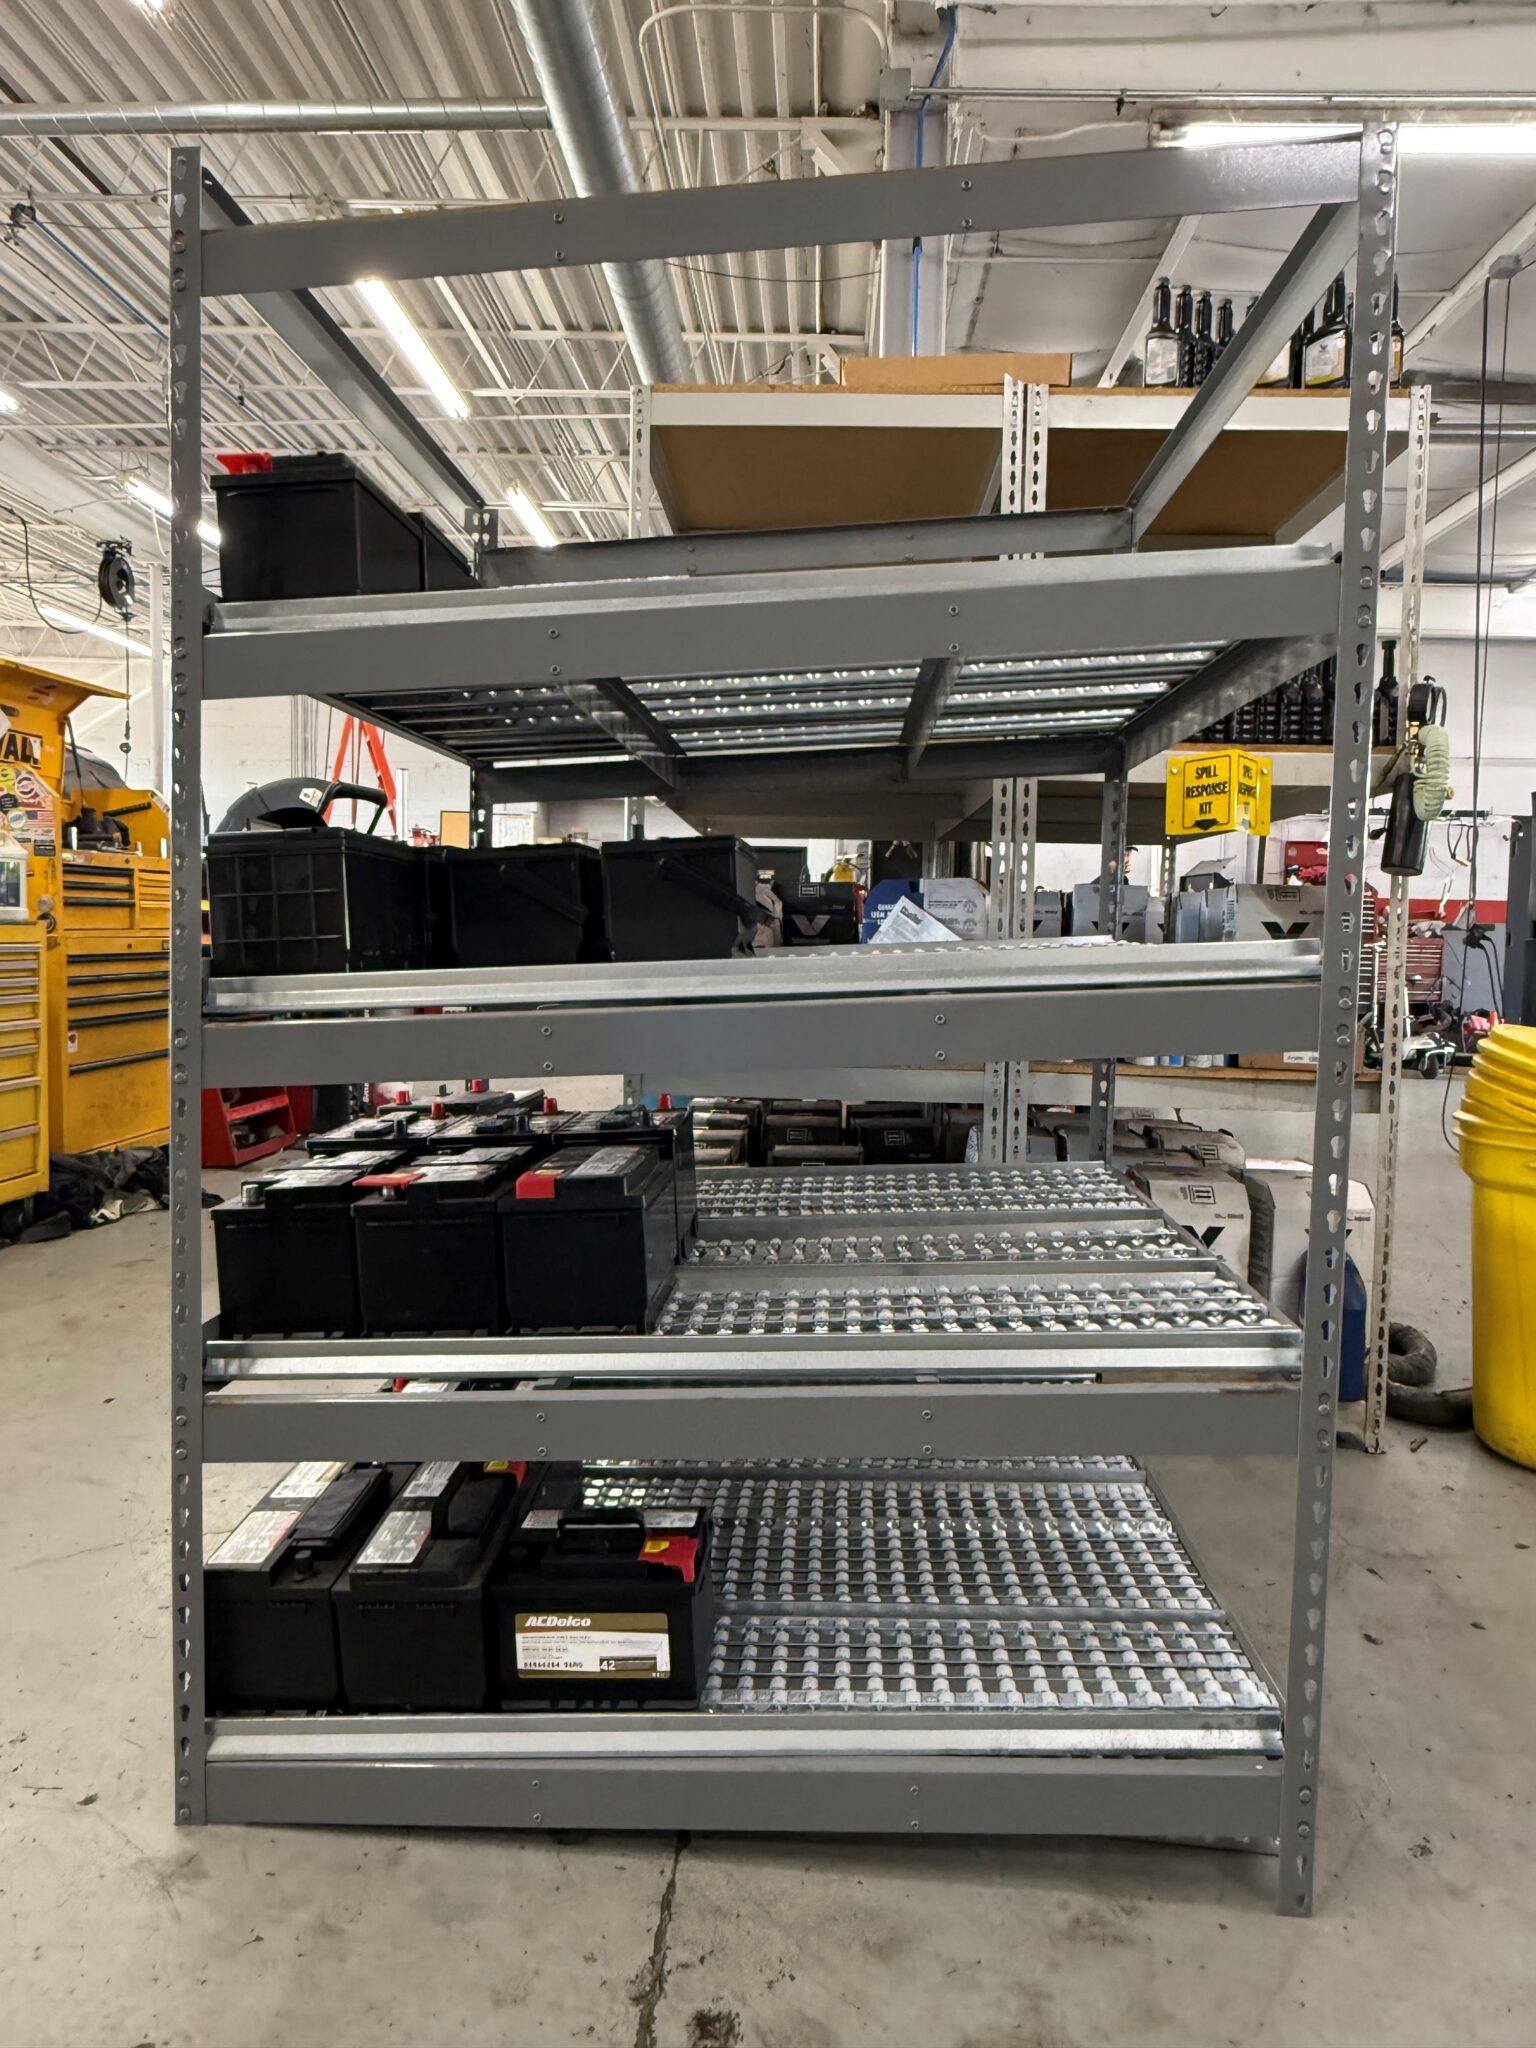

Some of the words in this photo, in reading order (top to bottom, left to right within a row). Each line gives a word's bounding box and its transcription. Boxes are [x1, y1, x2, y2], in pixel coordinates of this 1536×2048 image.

[1195, 765, 1218, 780] SPILL
[1185, 781, 1230, 799] RESPONSE
[1199, 801, 1213, 815] KIT
[525, 1615, 592, 1628] ACDelco
[600, 1660, 616, 1671] 42
